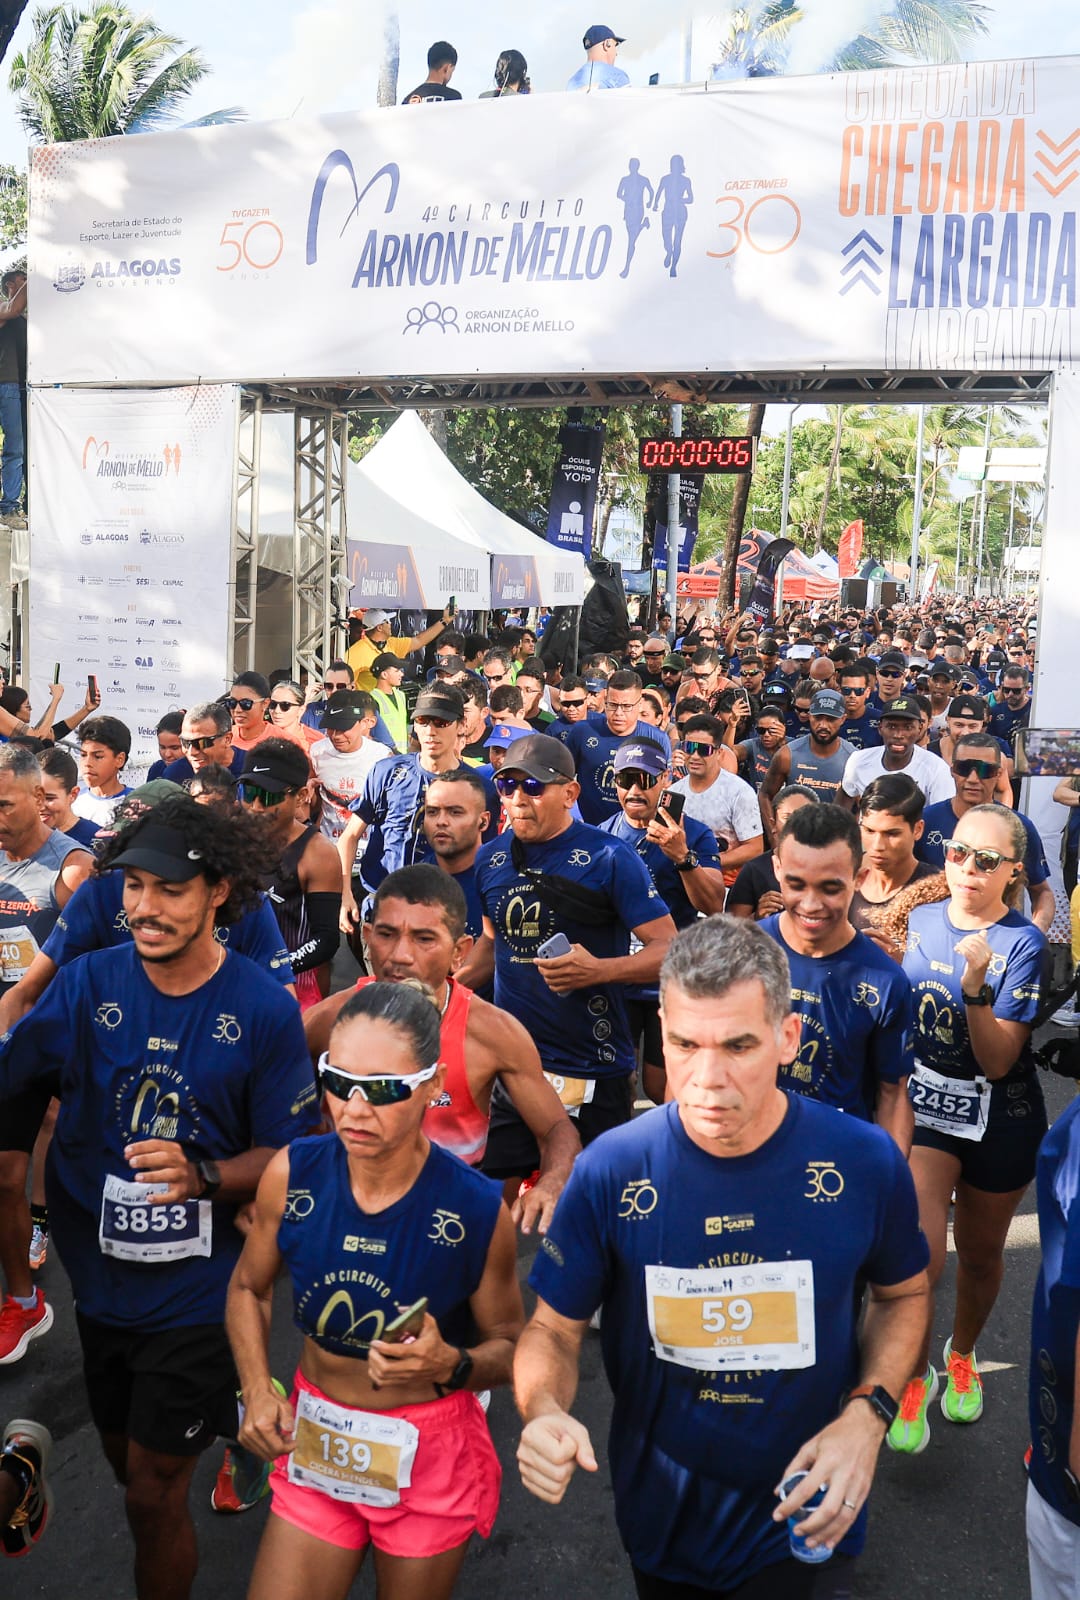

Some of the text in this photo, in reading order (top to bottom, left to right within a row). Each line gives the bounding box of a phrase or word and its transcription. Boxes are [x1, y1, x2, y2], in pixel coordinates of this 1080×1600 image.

[838, 118, 1025, 217] CHEGADA
[724, 178, 788, 191] GAZETAWEB
[92, 219, 130, 229] Secretaria
[143, 218, 168, 226] Estado
[169, 216, 182, 225] do
[448, 198, 584, 222] CIRCUITO
[79, 232, 111, 243] Esporte,
[113, 231, 132, 240] Lazer
[141, 229, 182, 239] Juventude
[706, 193, 802, 258] 30
[216, 221, 284, 271] 50
[351, 221, 613, 288] ARNON DE MELLO
[91, 258, 181, 279] ALAGOAS
[887, 211, 1076, 308] LARGADA
[96, 277, 176, 288] GOVERNO
[465, 307, 539, 320] ORGANIZAÇÃO
[464, 320, 575, 334] ARNON DE MELLO
[643, 439, 750, 466] 00:00:06
[97, 460, 128, 477] ARNON
[137, 459, 164, 477] MELLO
[567, 849, 591, 865] 30
[852, 984, 880, 1007] 30
[94, 1007, 122, 1028] 50
[212, 1017, 241, 1042] 30
[913, 1085, 972, 1116] 2452
[918, 1107, 945, 1119] DANIELLE
[804, 1168, 844, 1198] 30
[618, 1185, 658, 1217] 50
[114, 1205, 187, 1233] 3853
[427, 1213, 465, 1243] 30
[339, 1270, 391, 1298] CIRCUITO
[702, 1298, 753, 1333] 59
[714, 1335, 744, 1346] JOSE
[320, 1433, 371, 1473] 139
